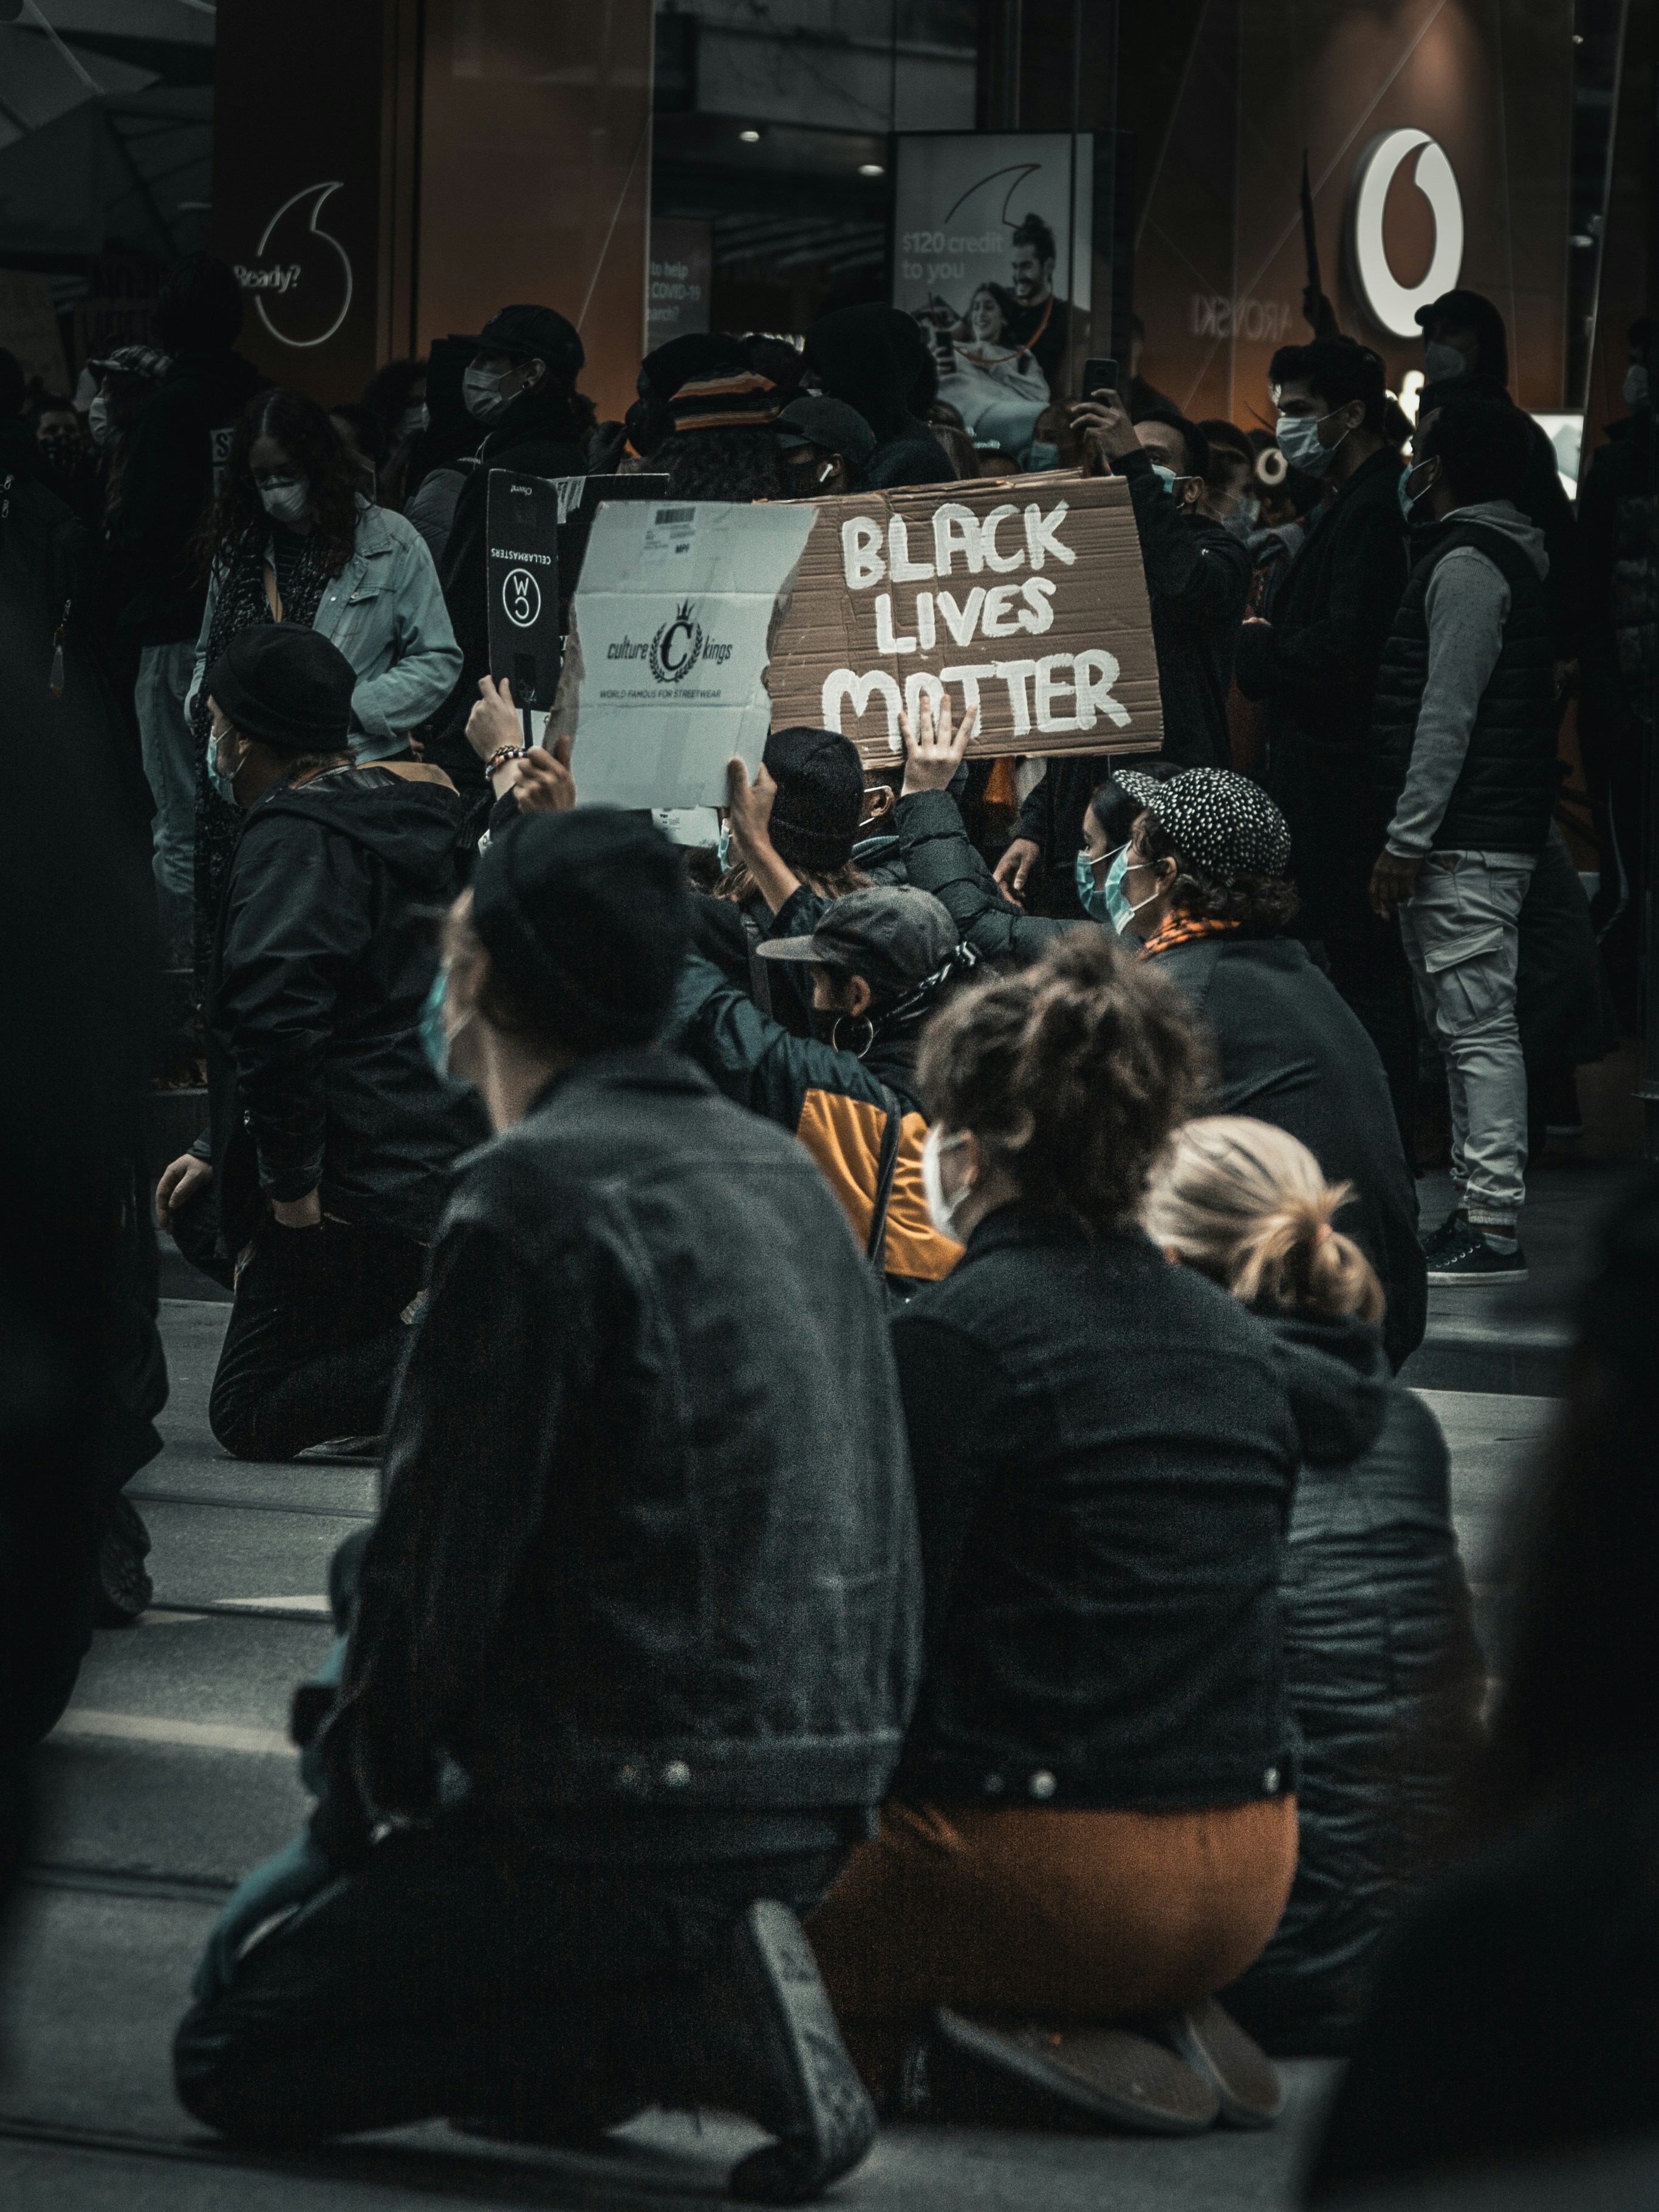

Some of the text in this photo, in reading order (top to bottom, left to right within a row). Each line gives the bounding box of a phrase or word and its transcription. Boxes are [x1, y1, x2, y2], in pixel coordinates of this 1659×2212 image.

[902, 230, 1004, 254] $120 credit
[234, 265, 301, 293] Ready?
[663, 261, 688, 281] help
[901, 260, 966, 285] to you
[651, 281, 702, 301] COVID-19
[490, 547, 552, 566] CELLARMASTERS
[841, 498, 1077, 590] BLACK
[874, 576, 1056, 654] LIVES
[607, 635, 649, 660] culture
[702, 635, 733, 665] kings
[600, 689, 722, 699] WORLD FAMOUS FOR STREETWEAR
[821, 648, 1132, 752] MATTER
